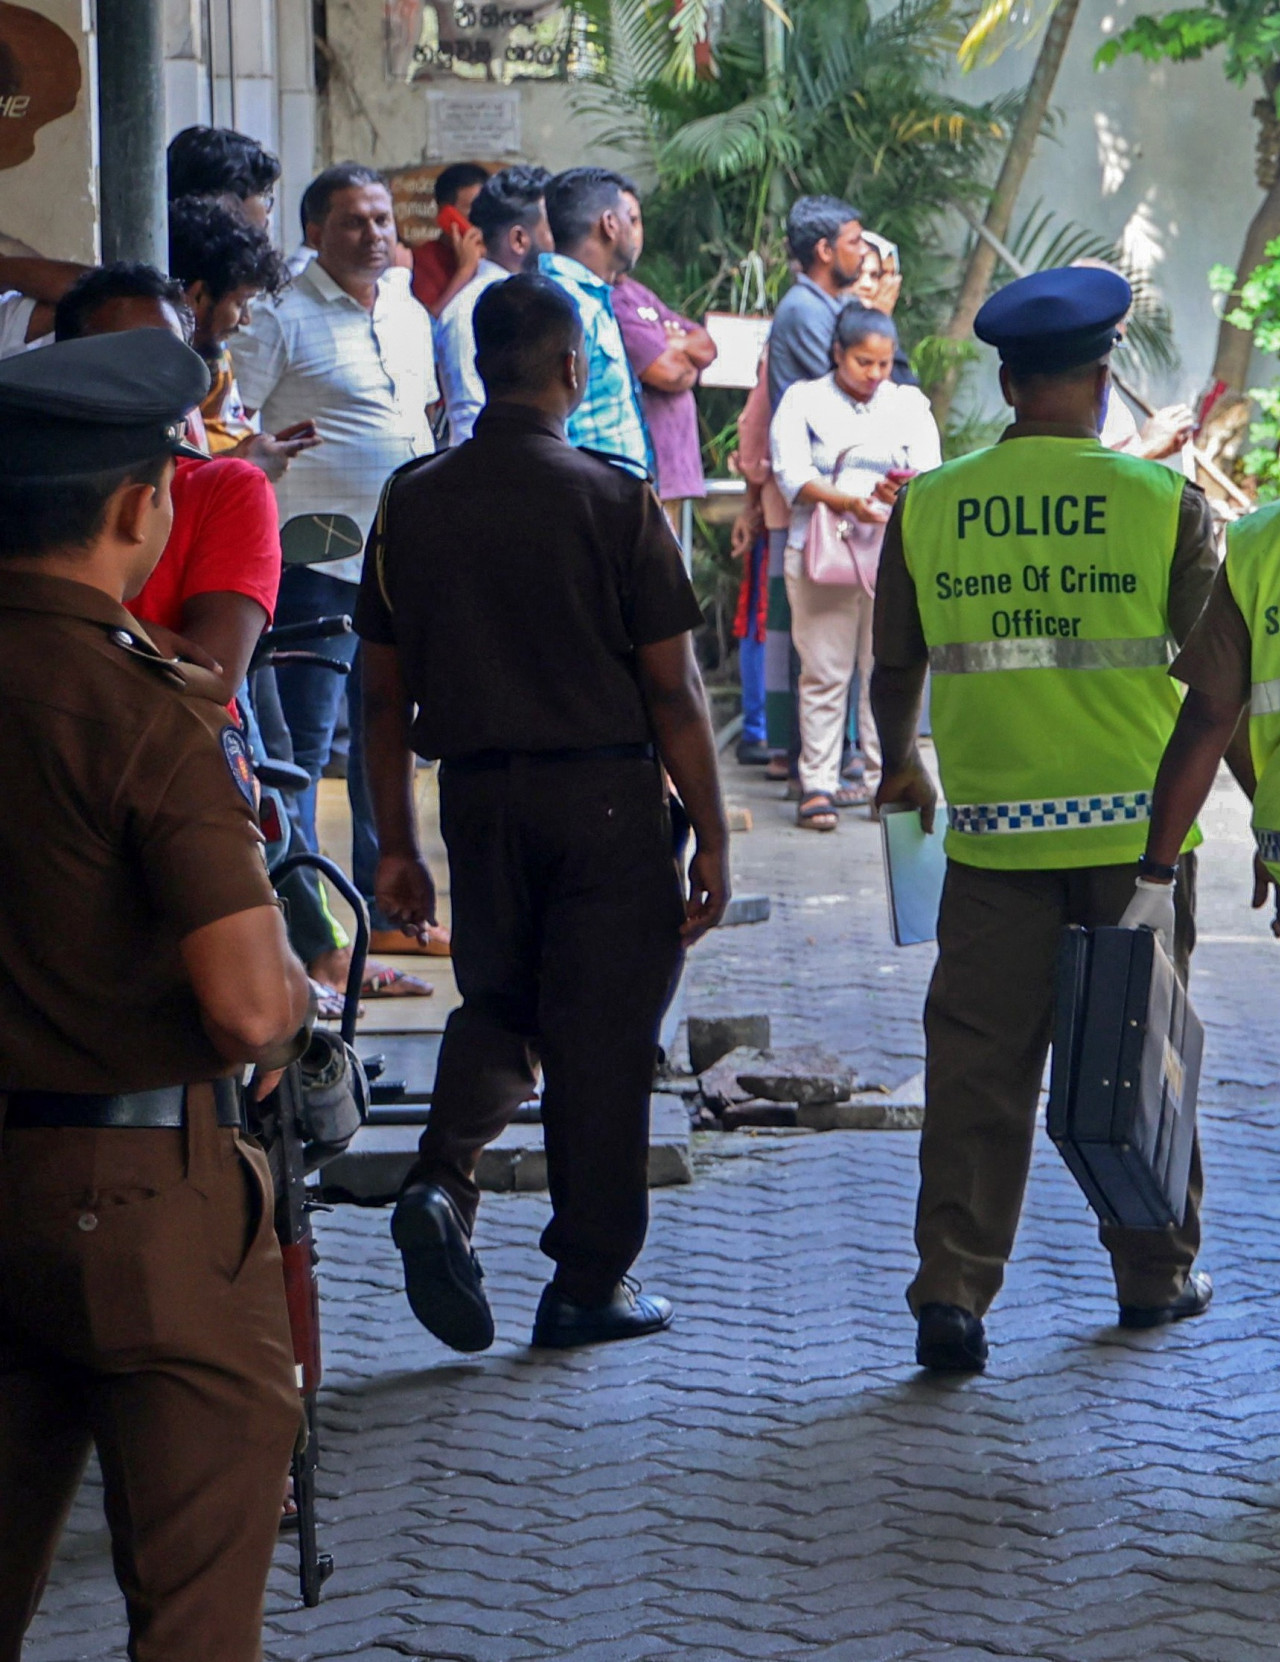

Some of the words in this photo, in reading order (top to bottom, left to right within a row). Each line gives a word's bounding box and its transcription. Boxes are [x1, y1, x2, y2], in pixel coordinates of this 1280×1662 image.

[957, 495, 1107, 539] POLICE
[935, 572, 1012, 600] Scene
[1023, 565, 1050, 593] Of
[1060, 565, 1137, 594] Crime
[991, 609, 1082, 638] Officer
